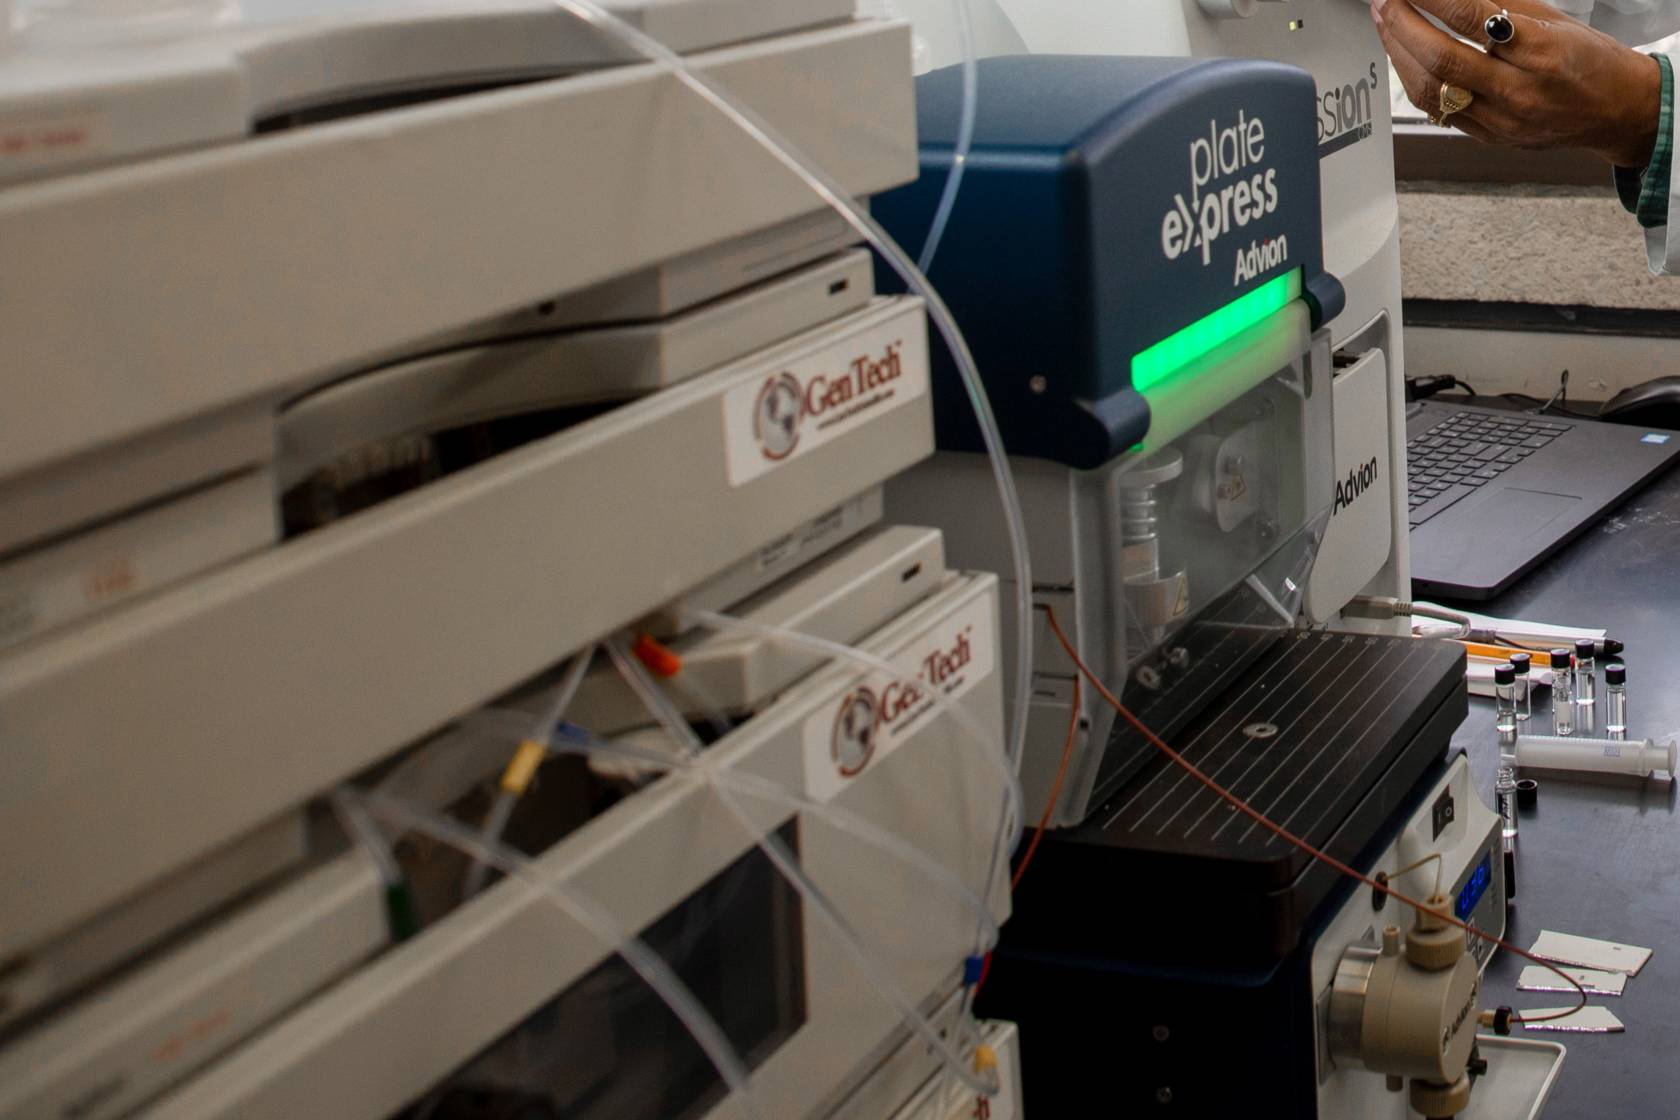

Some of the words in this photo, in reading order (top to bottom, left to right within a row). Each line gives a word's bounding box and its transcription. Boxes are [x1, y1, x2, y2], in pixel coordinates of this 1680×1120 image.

[1190, 109, 1265, 208] plate
[1234, 234, 1288, 286] Advion
[1333, 456, 1377, 516] Advion
